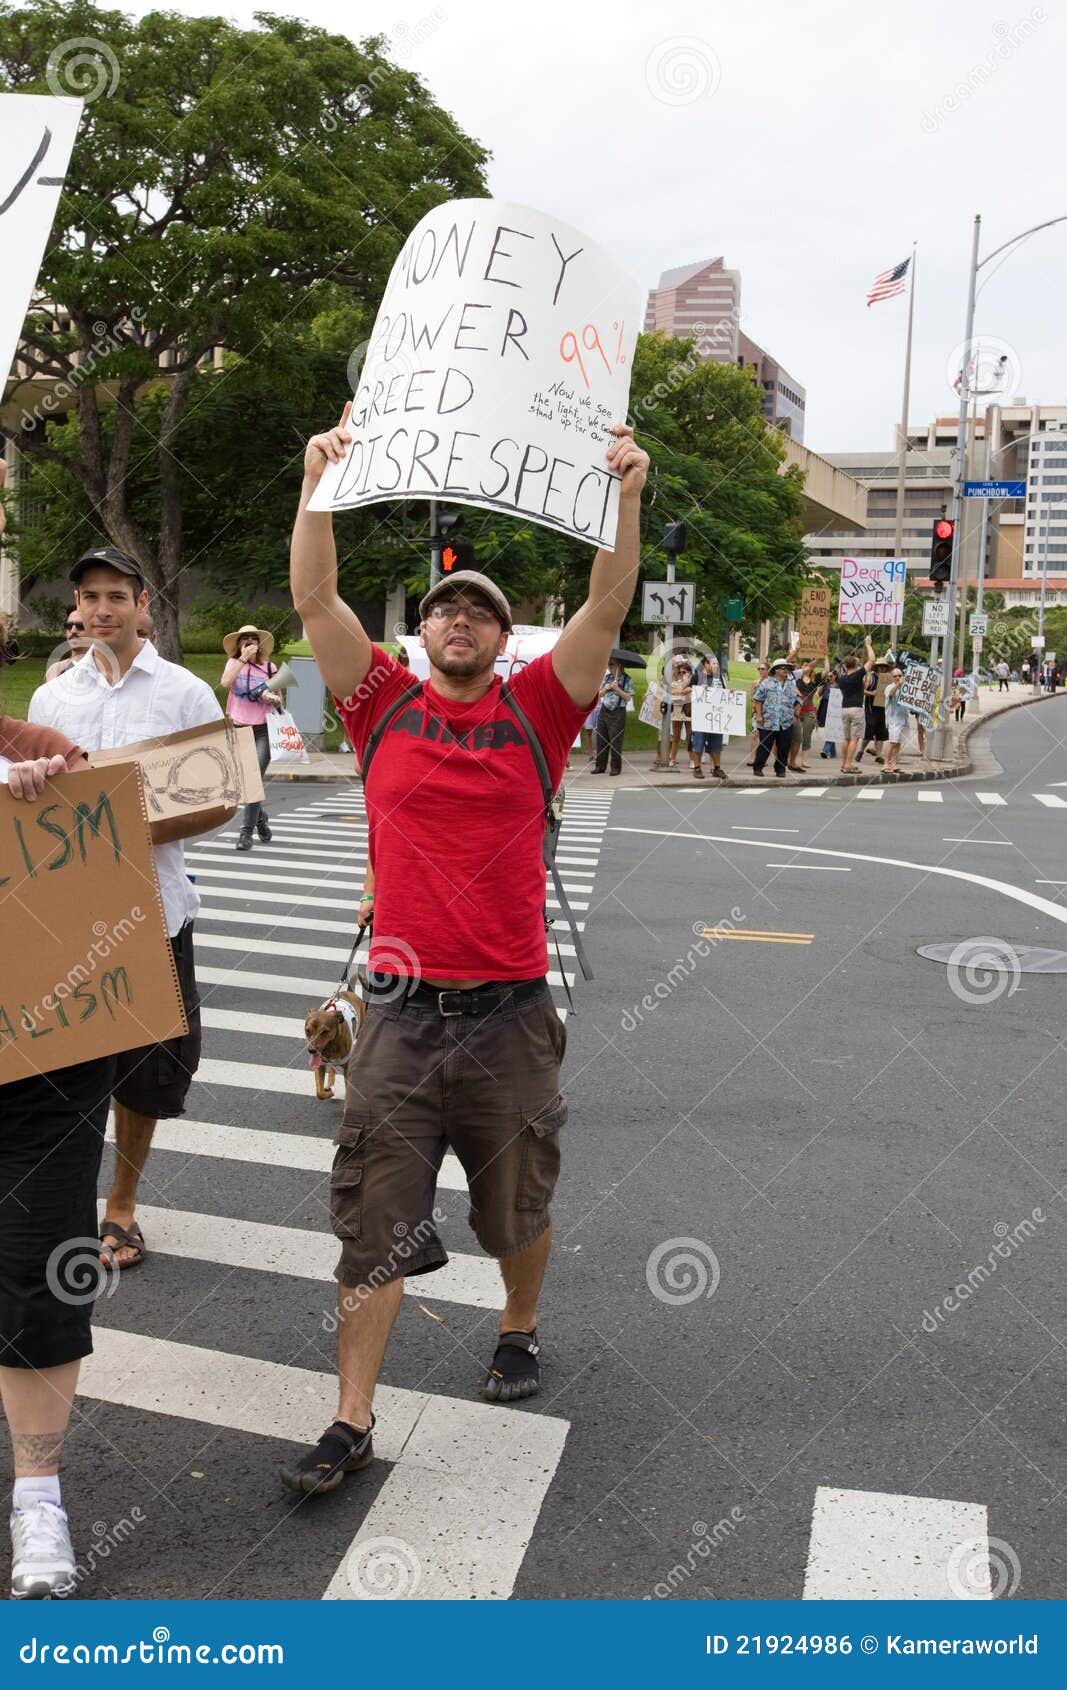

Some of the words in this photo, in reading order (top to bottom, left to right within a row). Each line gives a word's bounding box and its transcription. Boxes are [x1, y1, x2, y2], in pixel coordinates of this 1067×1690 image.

[396, 220, 584, 306] MONEY
[374, 303, 529, 362] POWER
[559, 320, 627, 390] 99%
[351, 368, 474, 428] GREED
[534, 392, 550, 406] the
[547, 381, 575, 401] Now
[333, 428, 623, 541] DISRESPECT
[967, 487, 1009, 497] PUNCHBOWL
[842, 559, 881, 581] Dear
[810, 590, 826, 602] END
[841, 579, 885, 599] What
[875, 591, 893, 603] Did
[839, 602, 901, 625] EXPECT
[932, 604, 943, 612] NO
[971, 625, 986, 634] 25
[694, 687, 713, 704] WE
[720, 692, 744, 706] ARE
[902, 683, 920, 697] OUT
[704, 711, 733, 732] 99%
[0, 791, 121, 886] ISM
